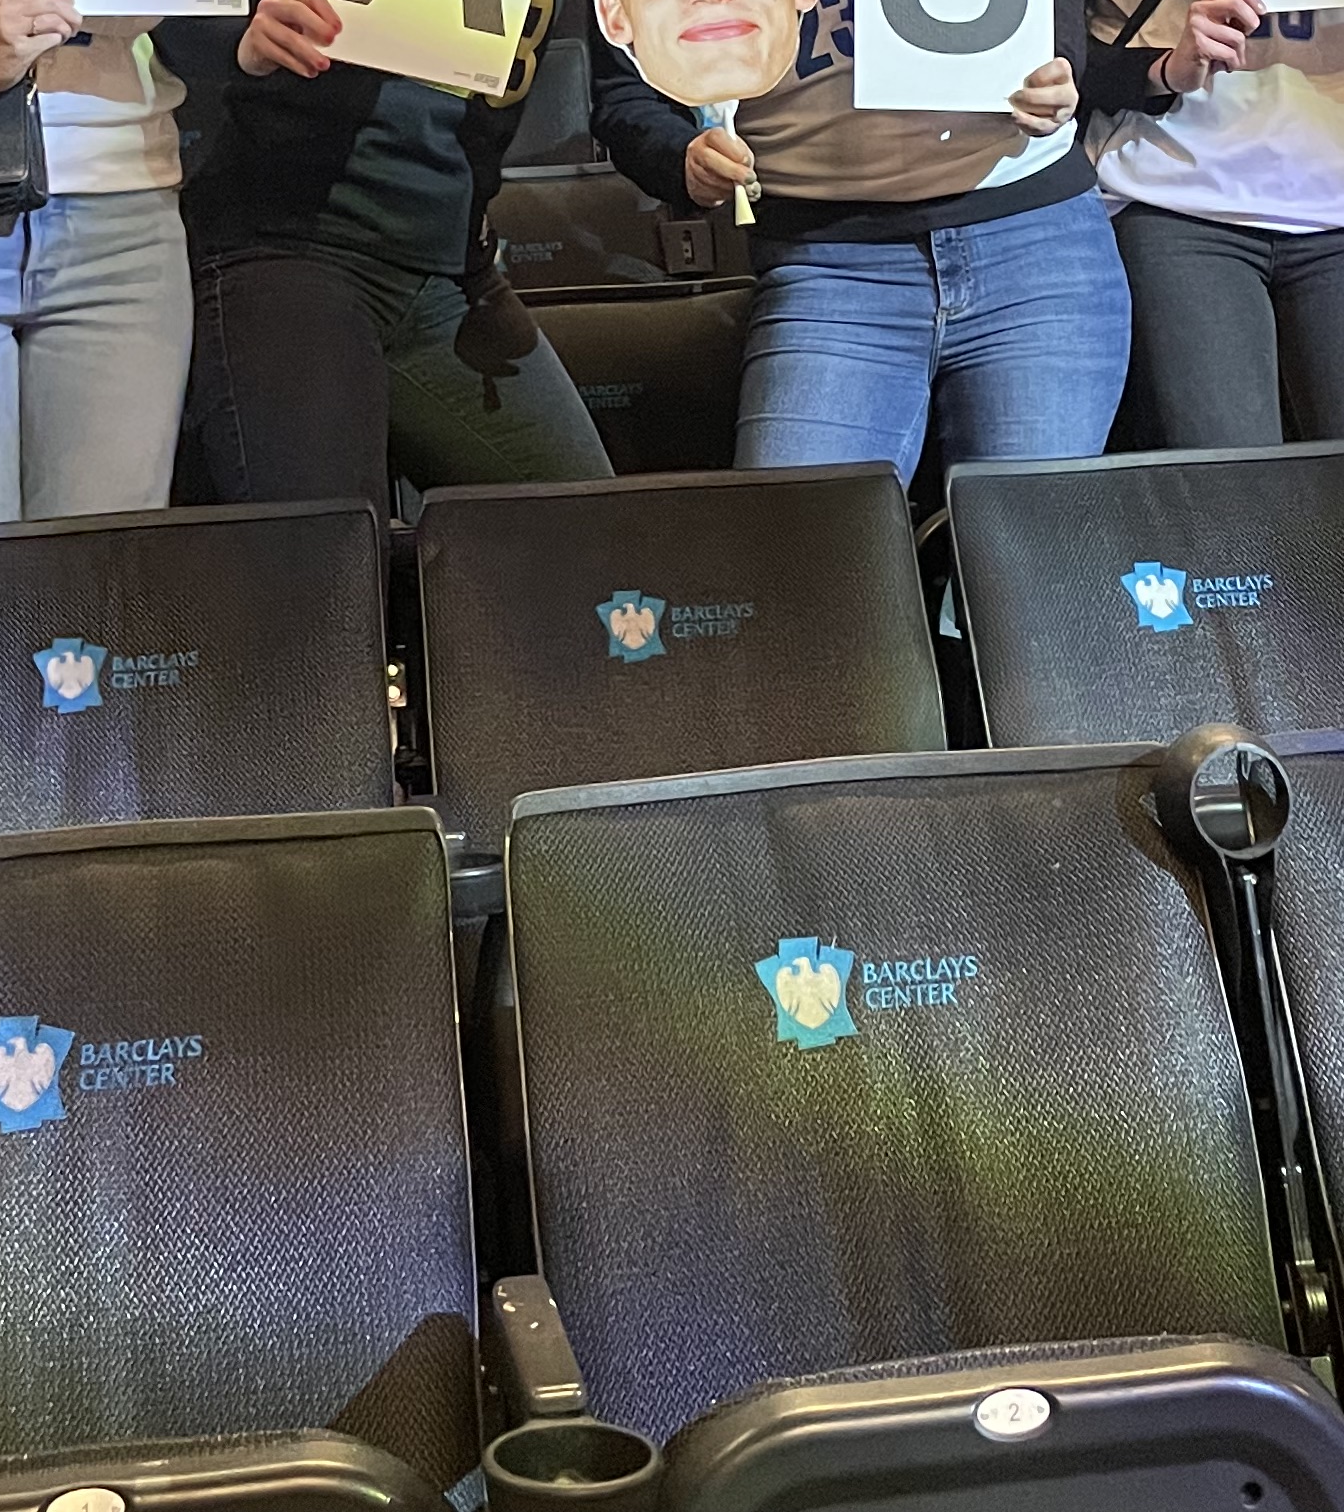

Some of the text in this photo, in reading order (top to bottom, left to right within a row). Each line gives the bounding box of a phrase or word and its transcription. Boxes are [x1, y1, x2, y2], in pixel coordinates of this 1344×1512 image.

[1193, 574, 1274, 593] BARCLAYS
[1195, 591, 1261, 609] CENTER
[671, 602, 755, 622] BARCLAYS
[672, 620, 740, 638] CENTER
[112, 650, 200, 671] BARCLAYS
[111, 669, 181, 688] CENTER
[862, 955, 978, 984] BARCLAYS
[864, 982, 958, 1010] CENTER
[79, 1035, 203, 1066] BARCLAYS
[79, 1063, 177, 1091] CENTER
[1008, 1402, 1021, 1422] 2
